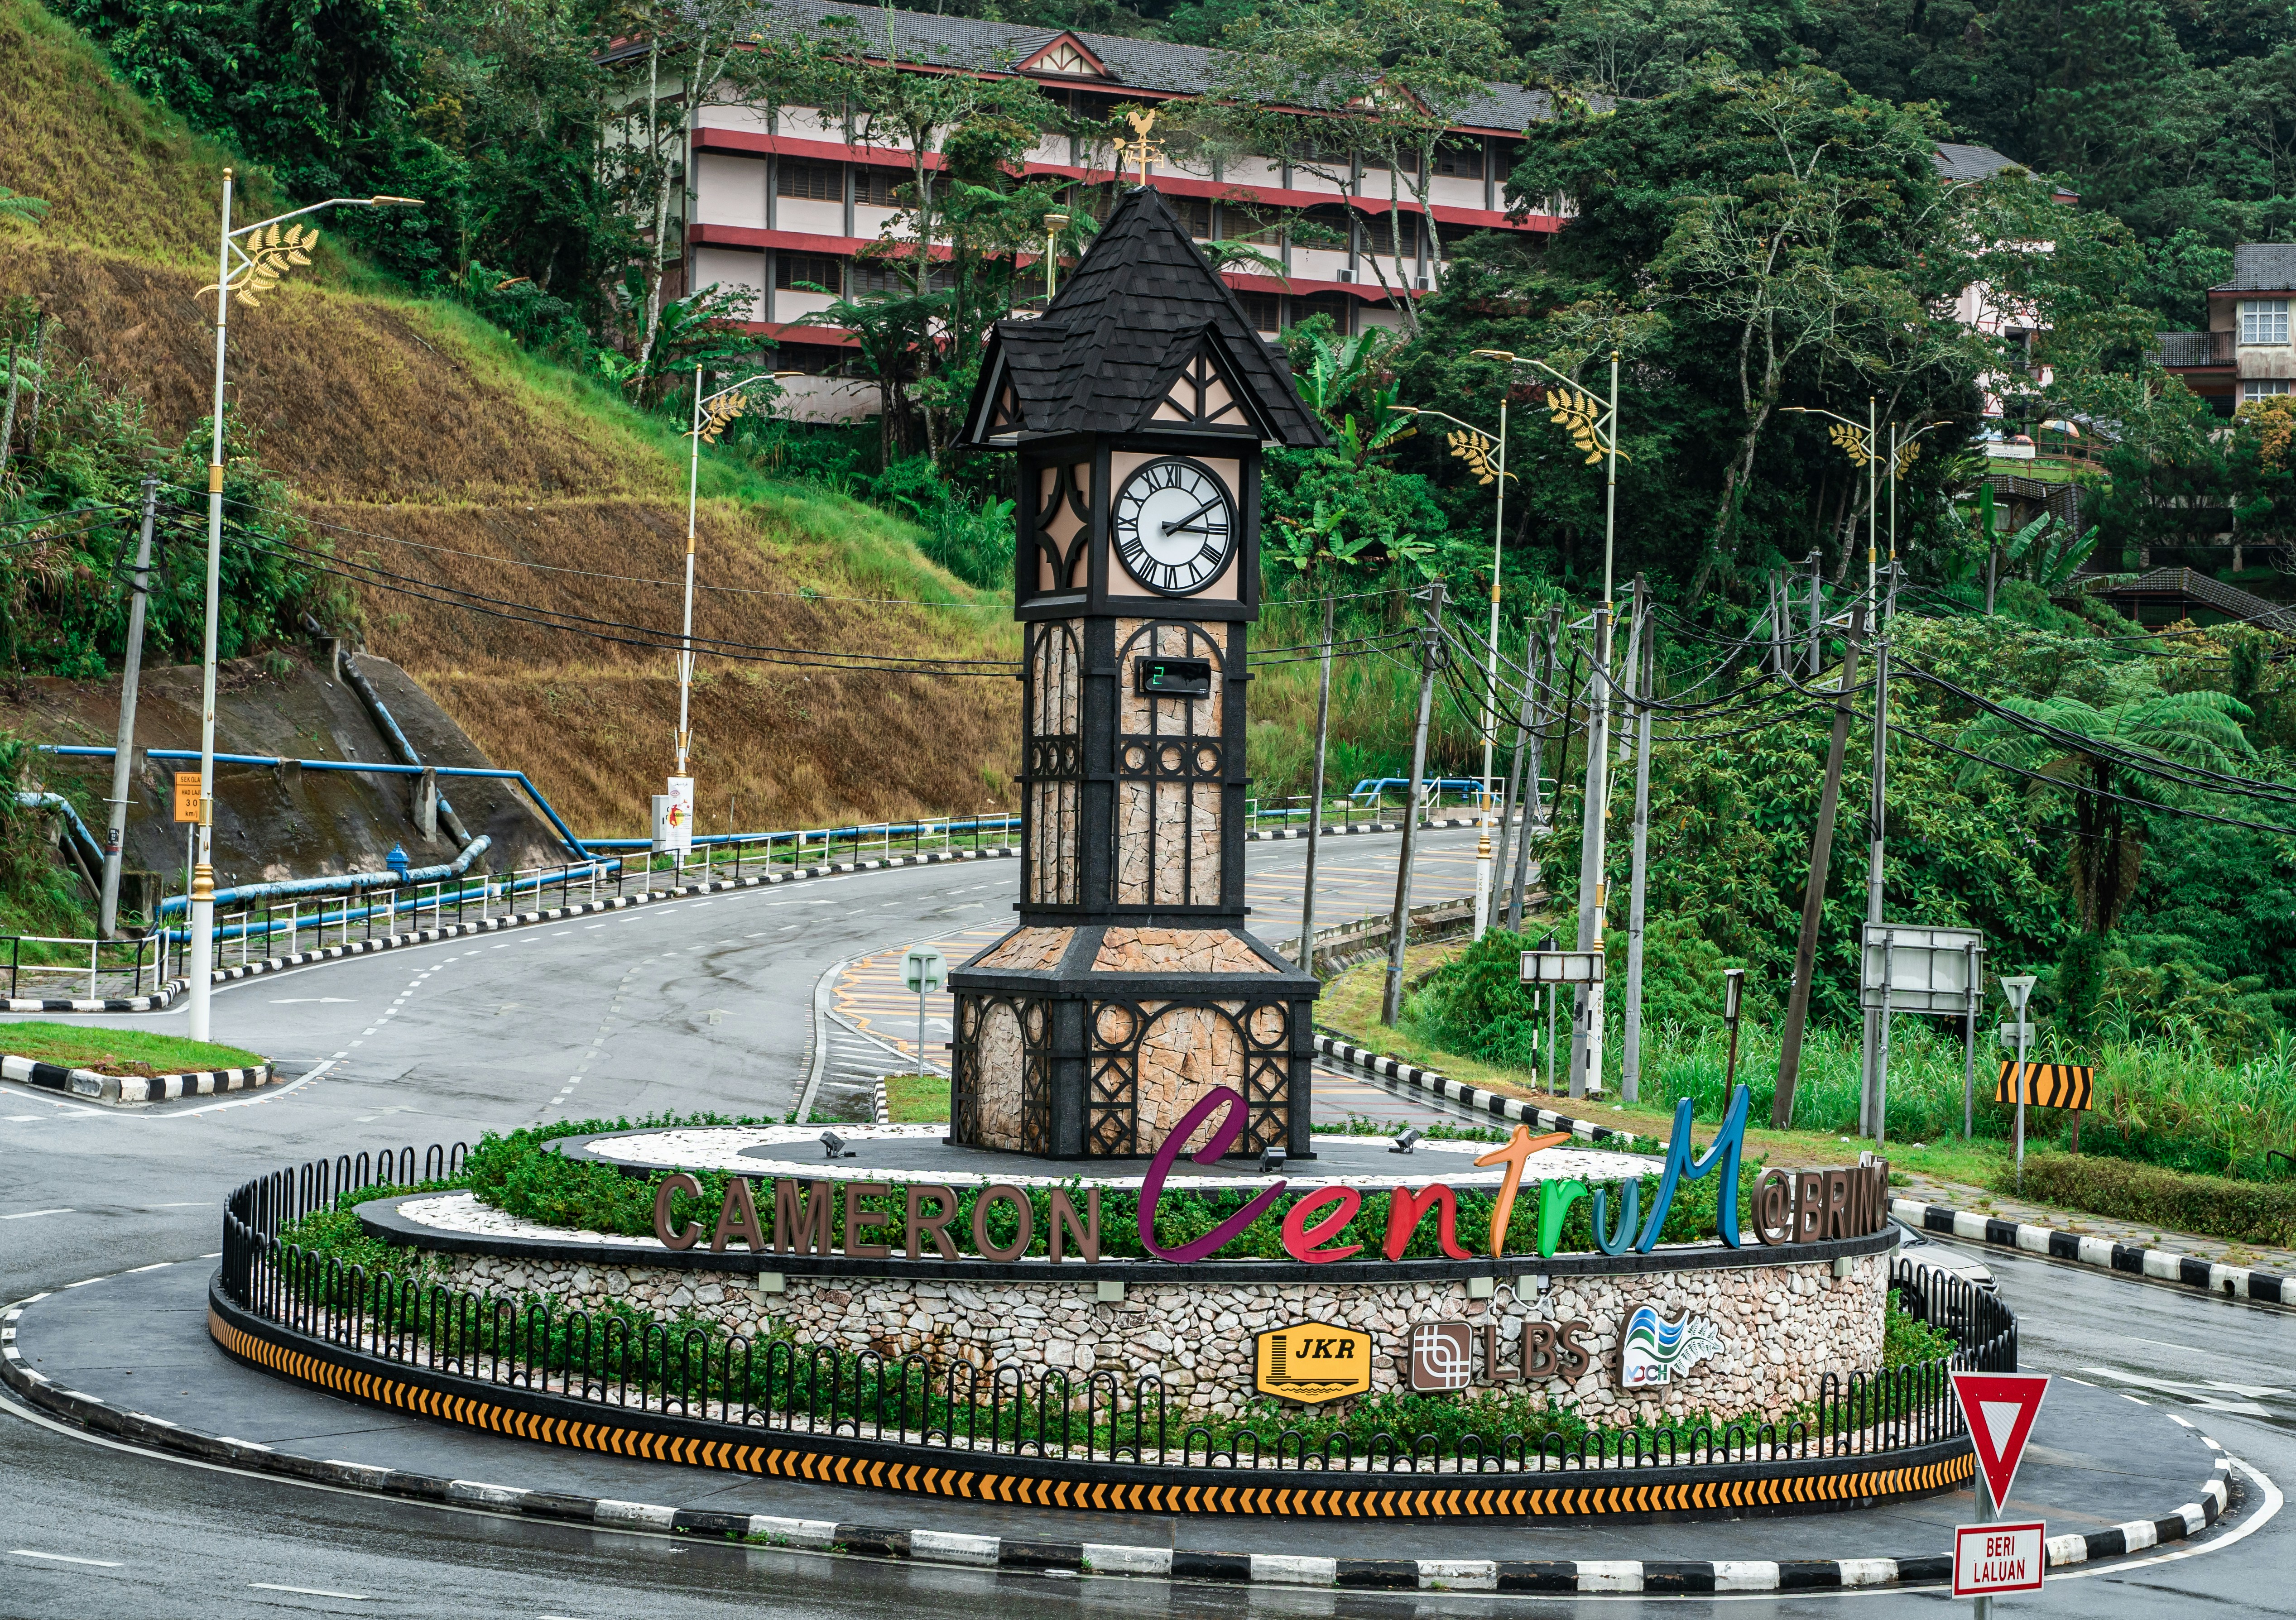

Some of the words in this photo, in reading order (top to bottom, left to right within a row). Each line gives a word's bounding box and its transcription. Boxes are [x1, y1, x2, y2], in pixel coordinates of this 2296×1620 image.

[1165, 465, 1182, 488] XII
[1153, 666, 1164, 685] 2
[653, 1173, 1100, 1263] CAMERON
[1296, 1339, 1355, 1359] JKR
[1484, 1319, 1590, 1380] LBS
[1987, 1536, 2014, 1558] BERI
[1974, 1558, 2025, 1583] LALUAN
